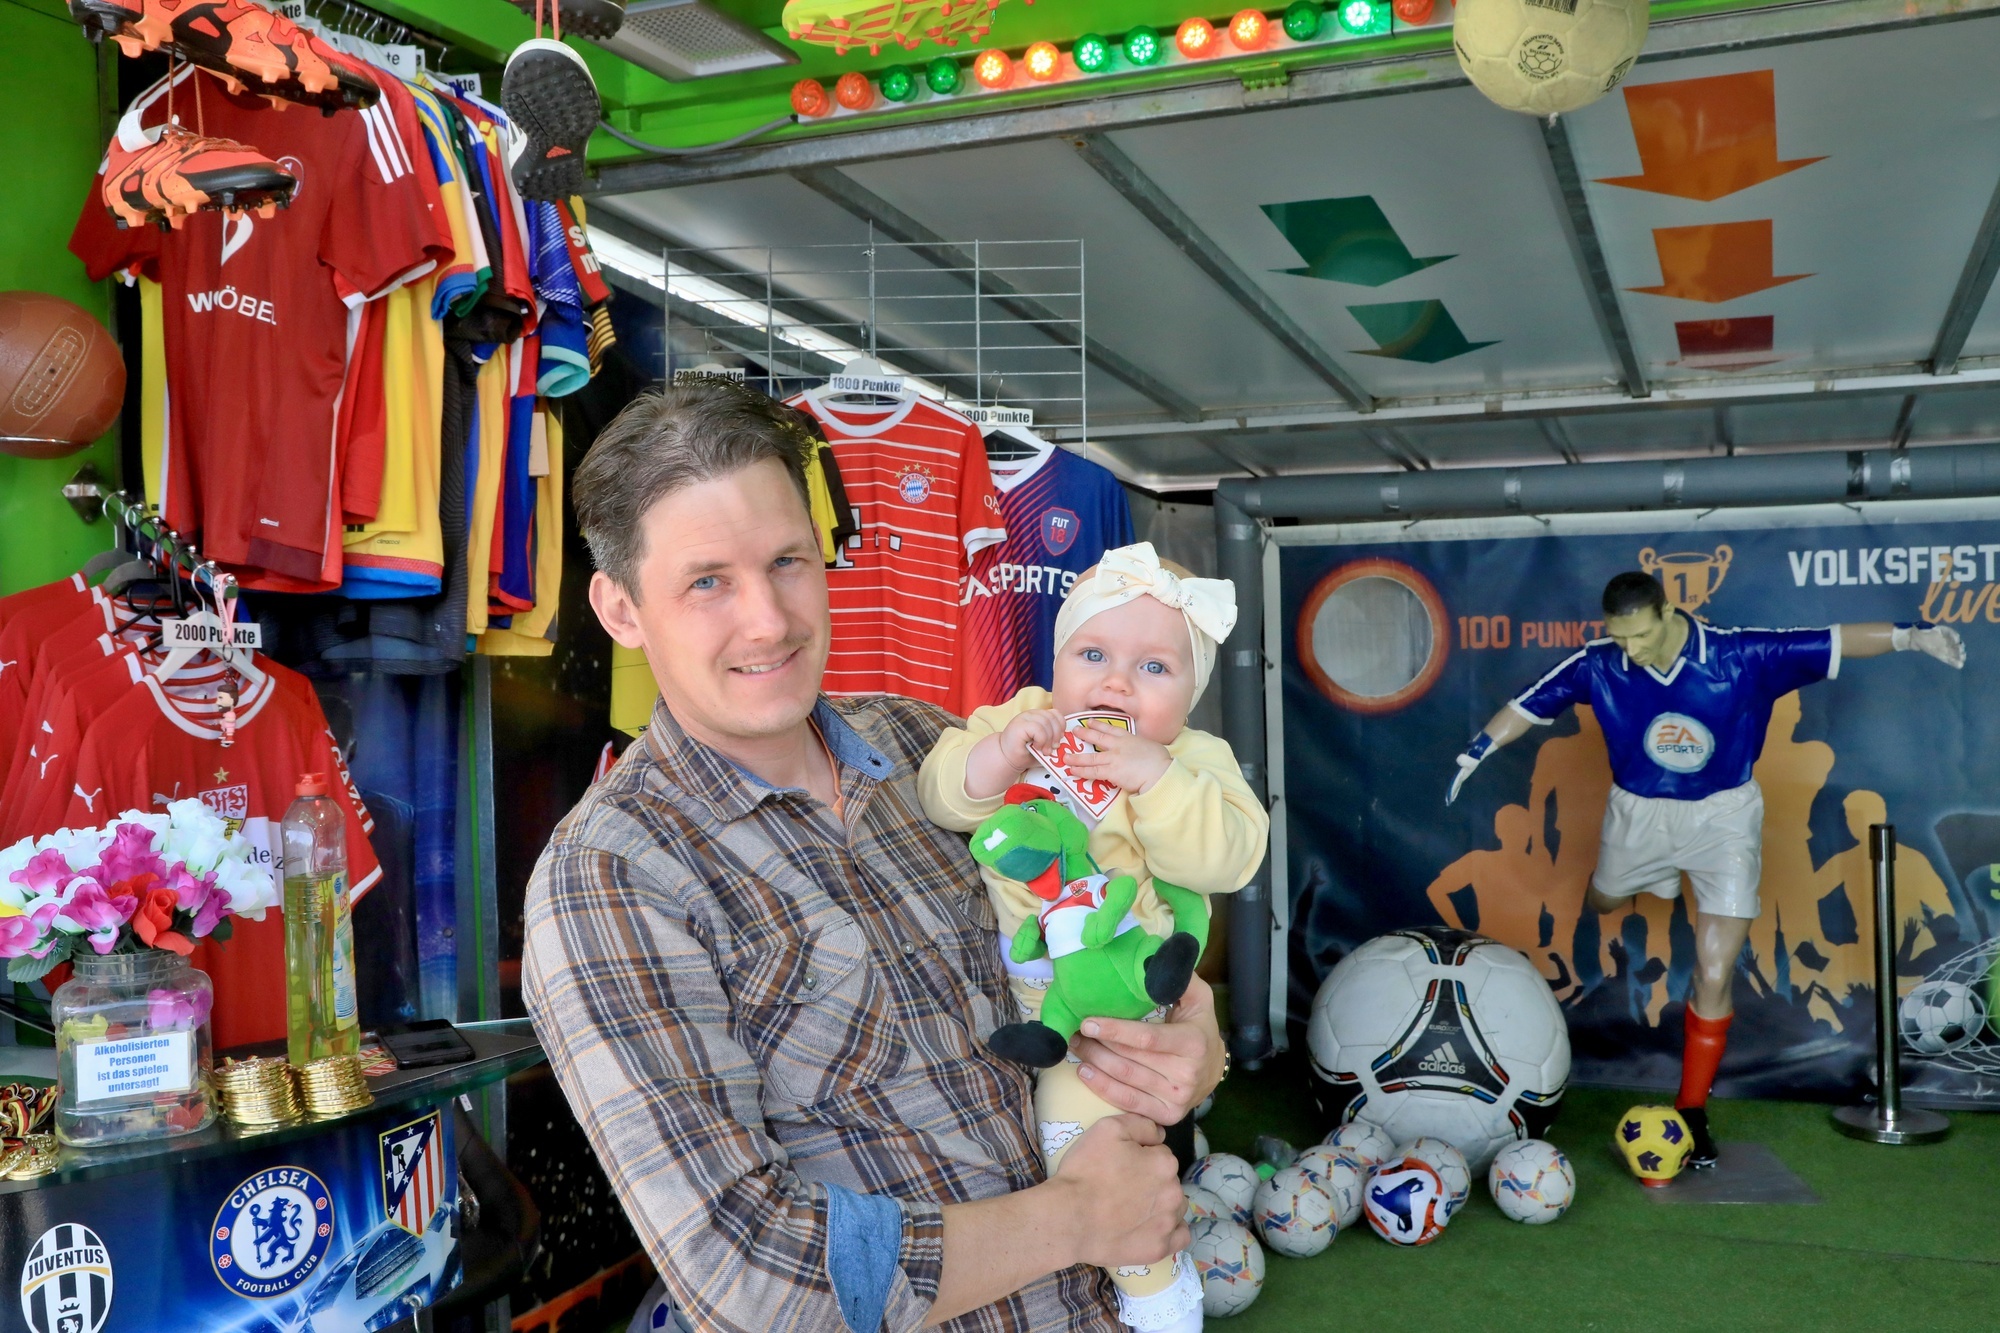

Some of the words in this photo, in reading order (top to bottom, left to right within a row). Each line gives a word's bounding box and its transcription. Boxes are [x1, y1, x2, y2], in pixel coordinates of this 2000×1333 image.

[832, 377, 859, 390] 1800
[861, 378, 902, 393] Punkte
[990, 411, 1030, 423] Punkte
[1051, 516, 1069, 529] FUT
[1050, 527, 1067, 543] 18
[1788, 544, 2000, 587] VOLKSFEST
[175, 623, 206, 641] 2000
[209, 627, 256, 644] Pukte
[1458, 615, 1511, 649] 100
[1521, 620, 1607, 649] PUNKT
[1657, 724, 1702, 745] EA
[1657, 744, 1704, 754] SPORTS
[94, 1039, 170, 1056] Alkoholisierten
[109, 1053, 156, 1067] Personen
[1418, 1060, 1466, 1075] adidas
[97, 1071, 111, 1081] ist
[112, 1069, 131, 1080] das
[132, 1064, 169, 1077] spielen
[108, 1077, 160, 1093] untersagt!
[230, 1170, 310, 1209] CHELSEA
[28, 1249, 104, 1281] JUVENTUS
[236, 1278, 291, 1293] FOOTBALL
[294, 1254, 318, 1280] CLUB
